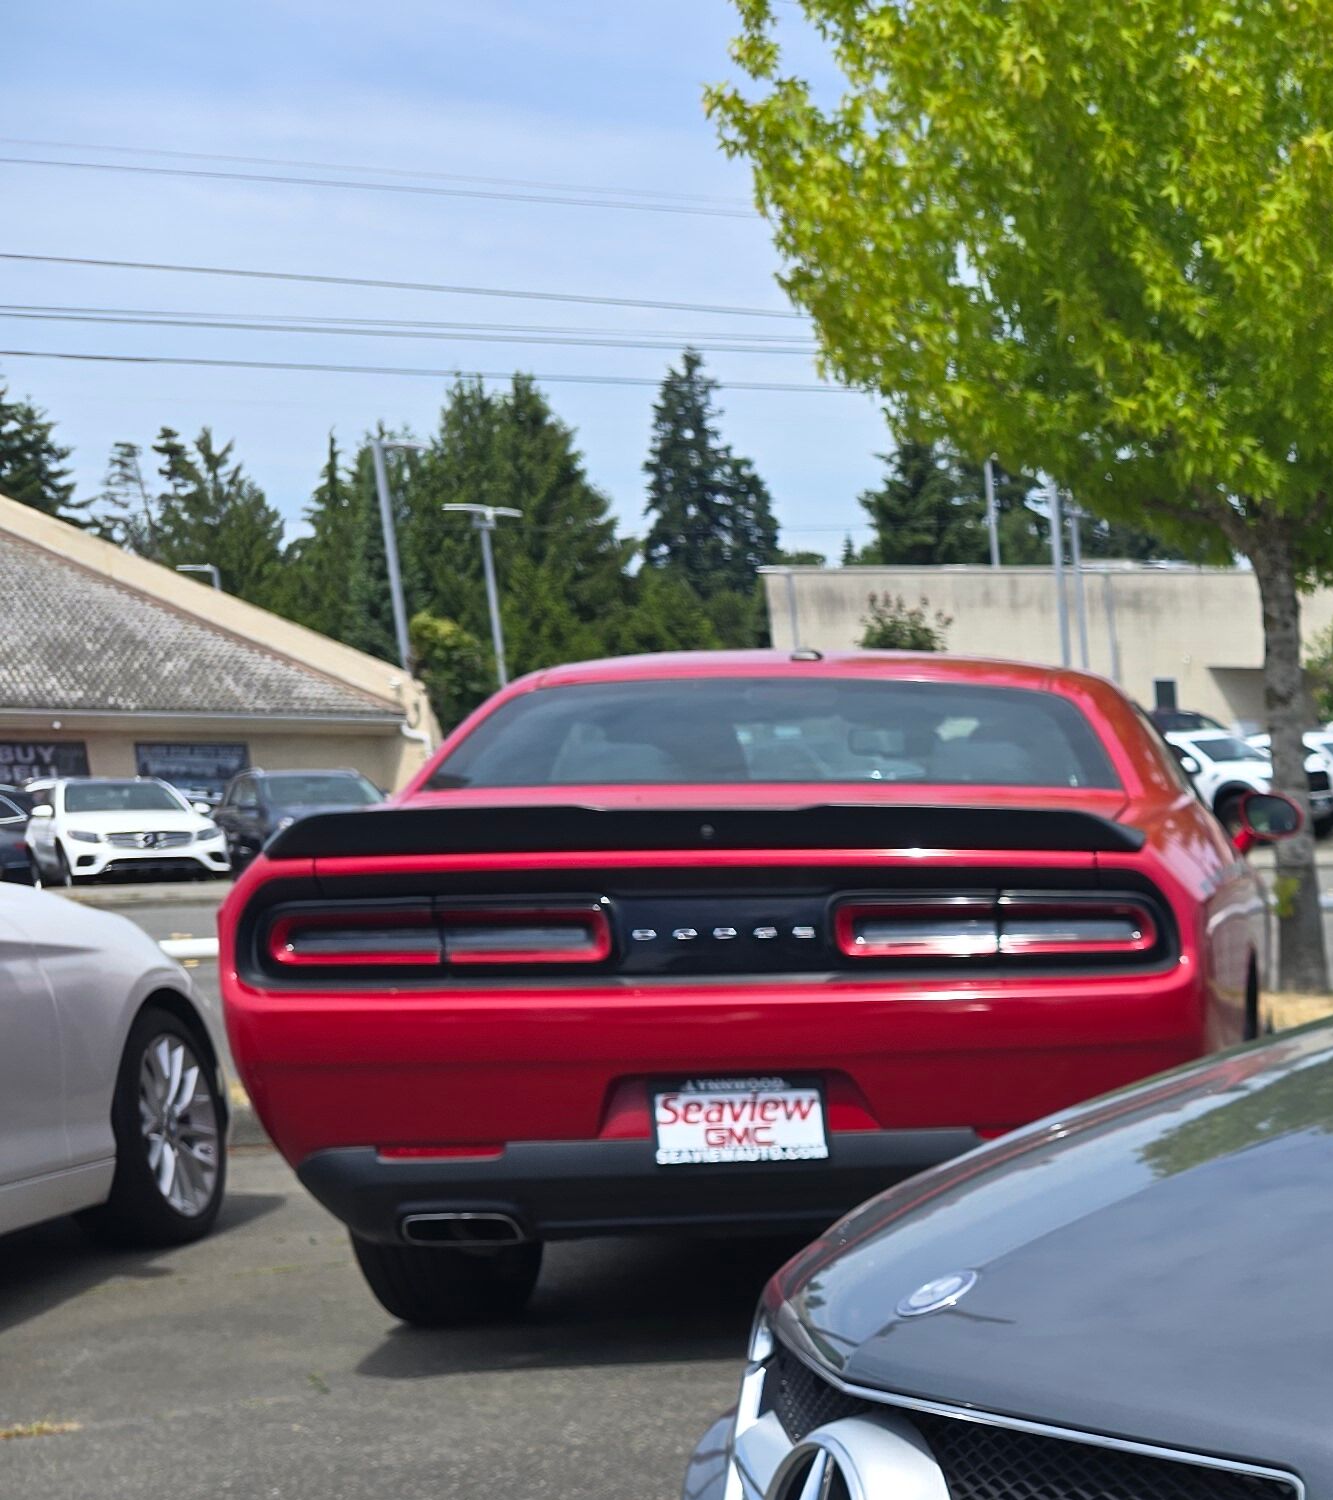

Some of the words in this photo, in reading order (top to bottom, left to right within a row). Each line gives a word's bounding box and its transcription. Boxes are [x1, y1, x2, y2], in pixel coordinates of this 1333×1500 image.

[632, 926, 816, 941] DODGE
[685, 1077, 784, 1091] LYNNWOOD
[657, 1091, 816, 1126] Seaview
[705, 1126, 775, 1147] GMC
